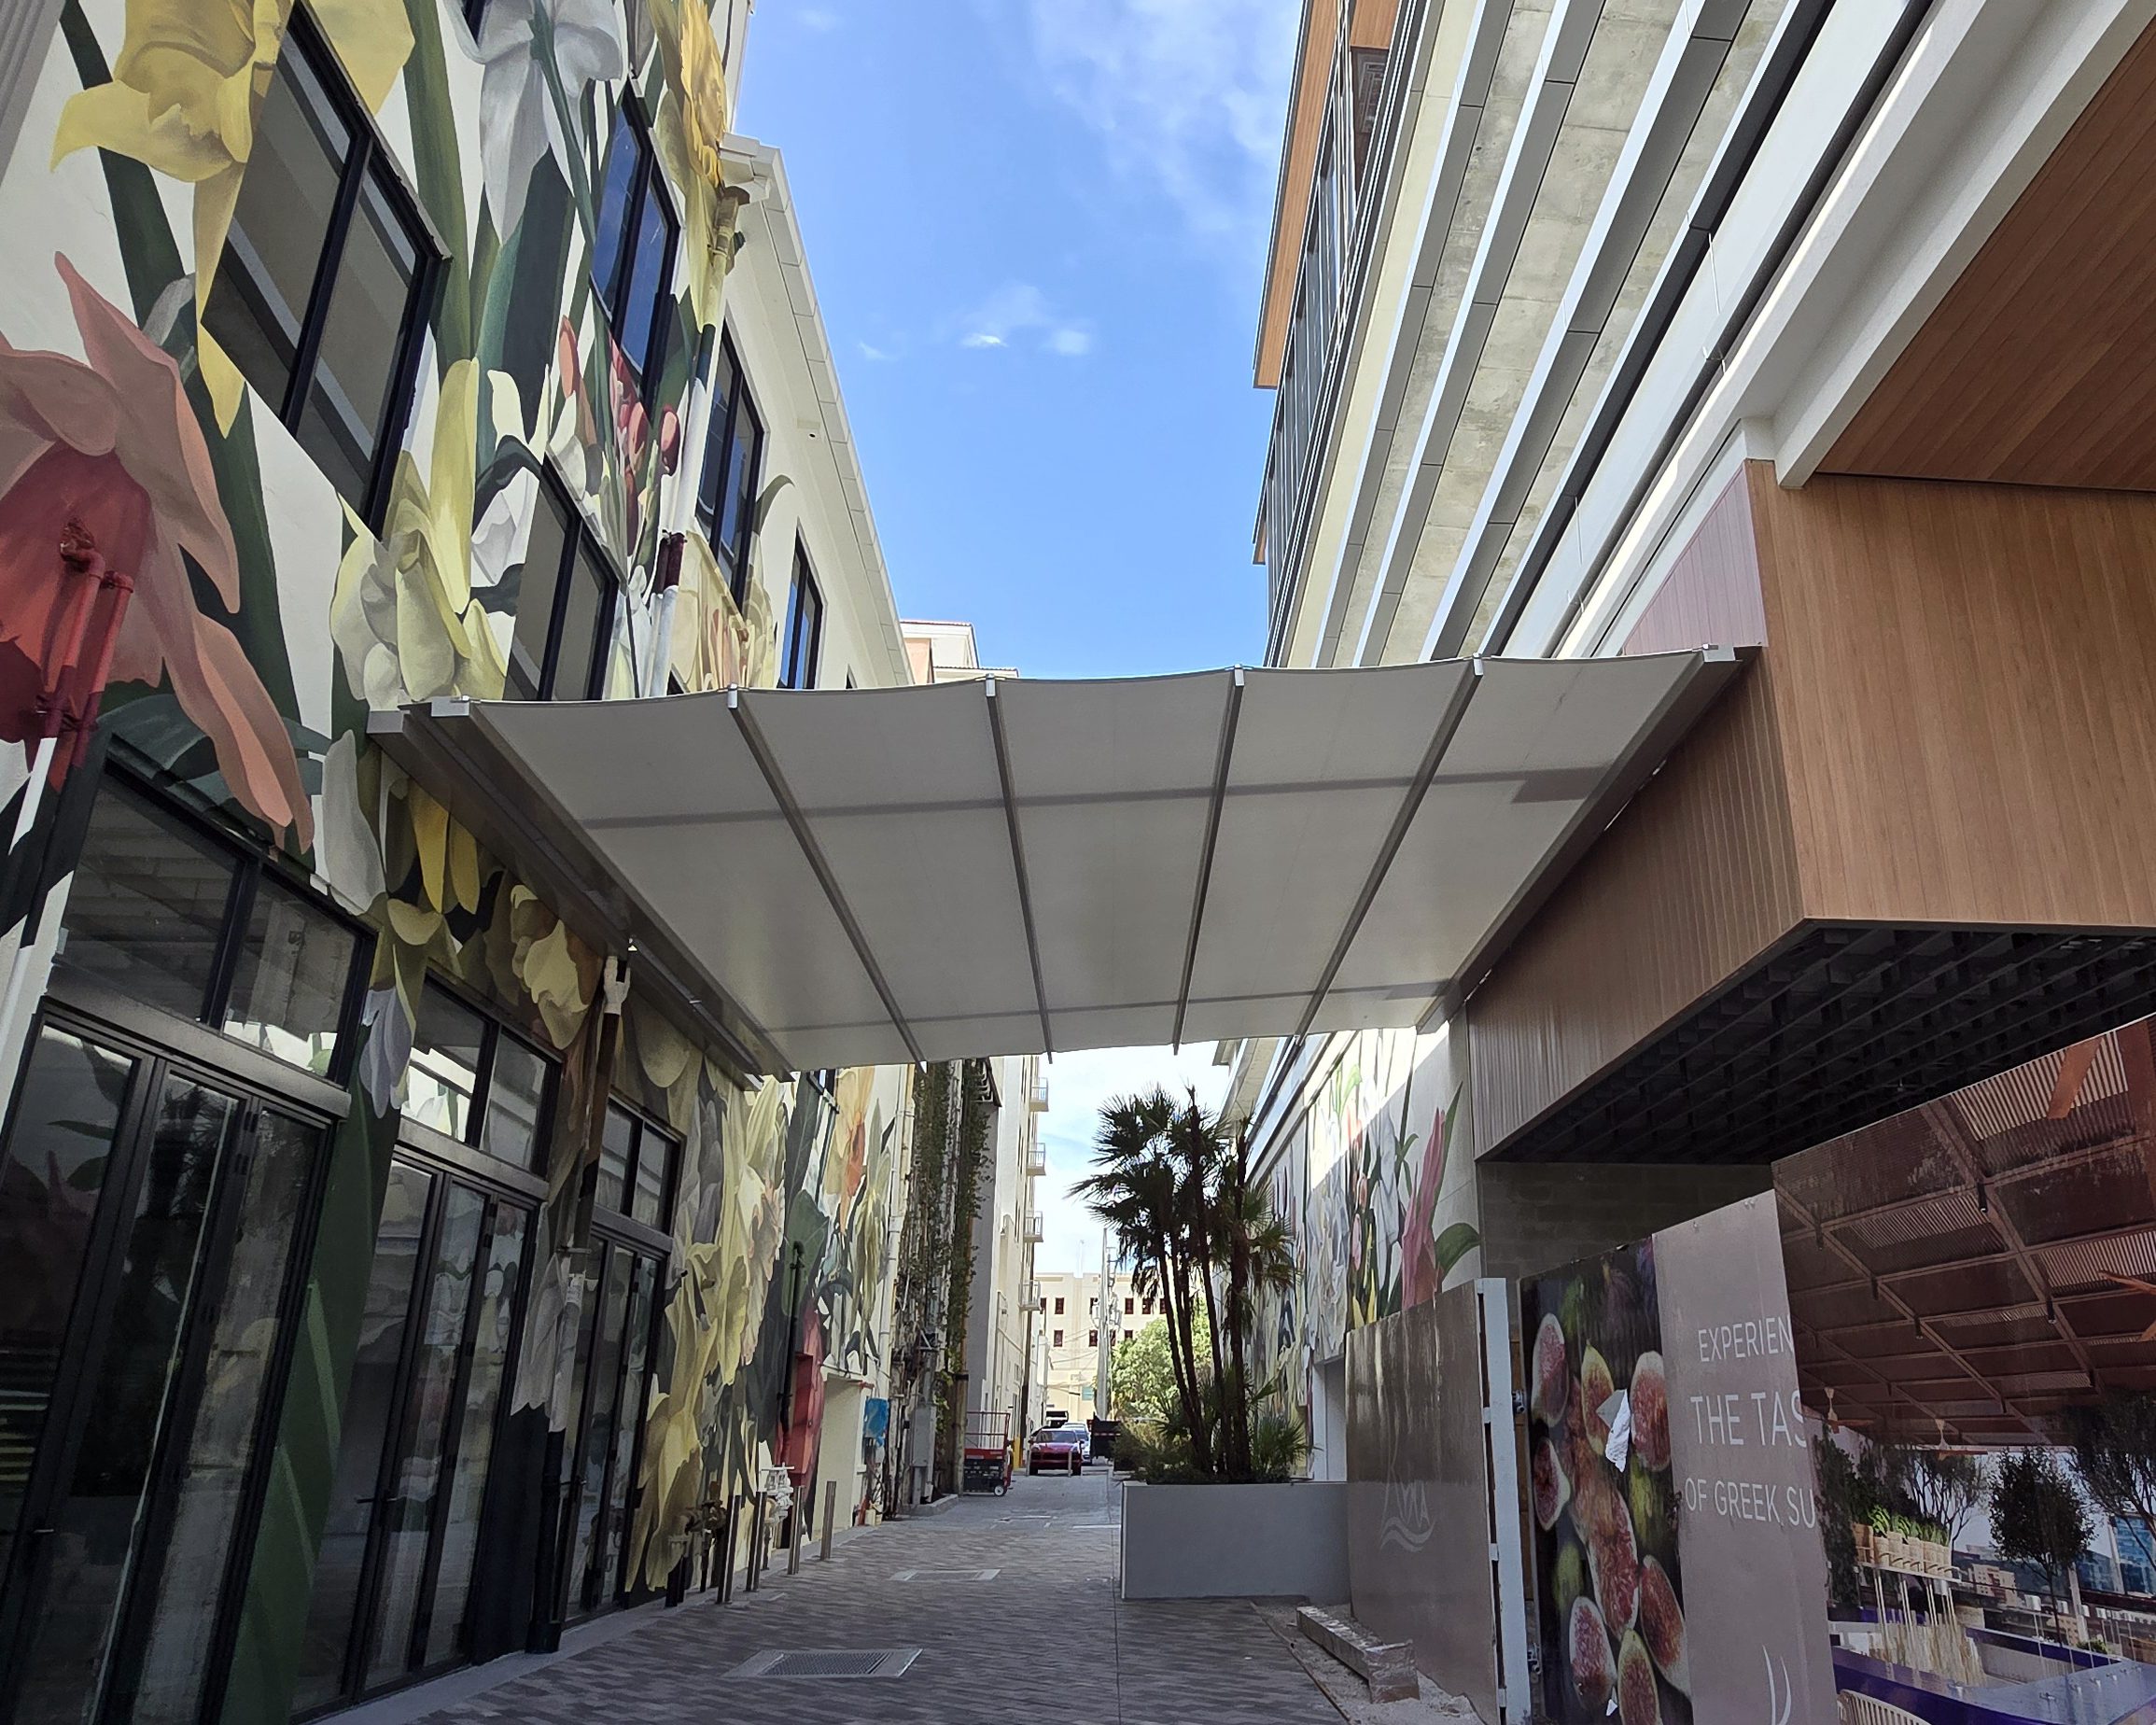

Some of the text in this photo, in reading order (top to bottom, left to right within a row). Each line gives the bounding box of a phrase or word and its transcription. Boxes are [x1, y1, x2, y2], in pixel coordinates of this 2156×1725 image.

[1698, 1315, 1794, 1362] EXPERIEN
[1690, 1390, 1807, 1448] THE TAS
[1684, 1478, 1817, 1528] OF GREEK SU
